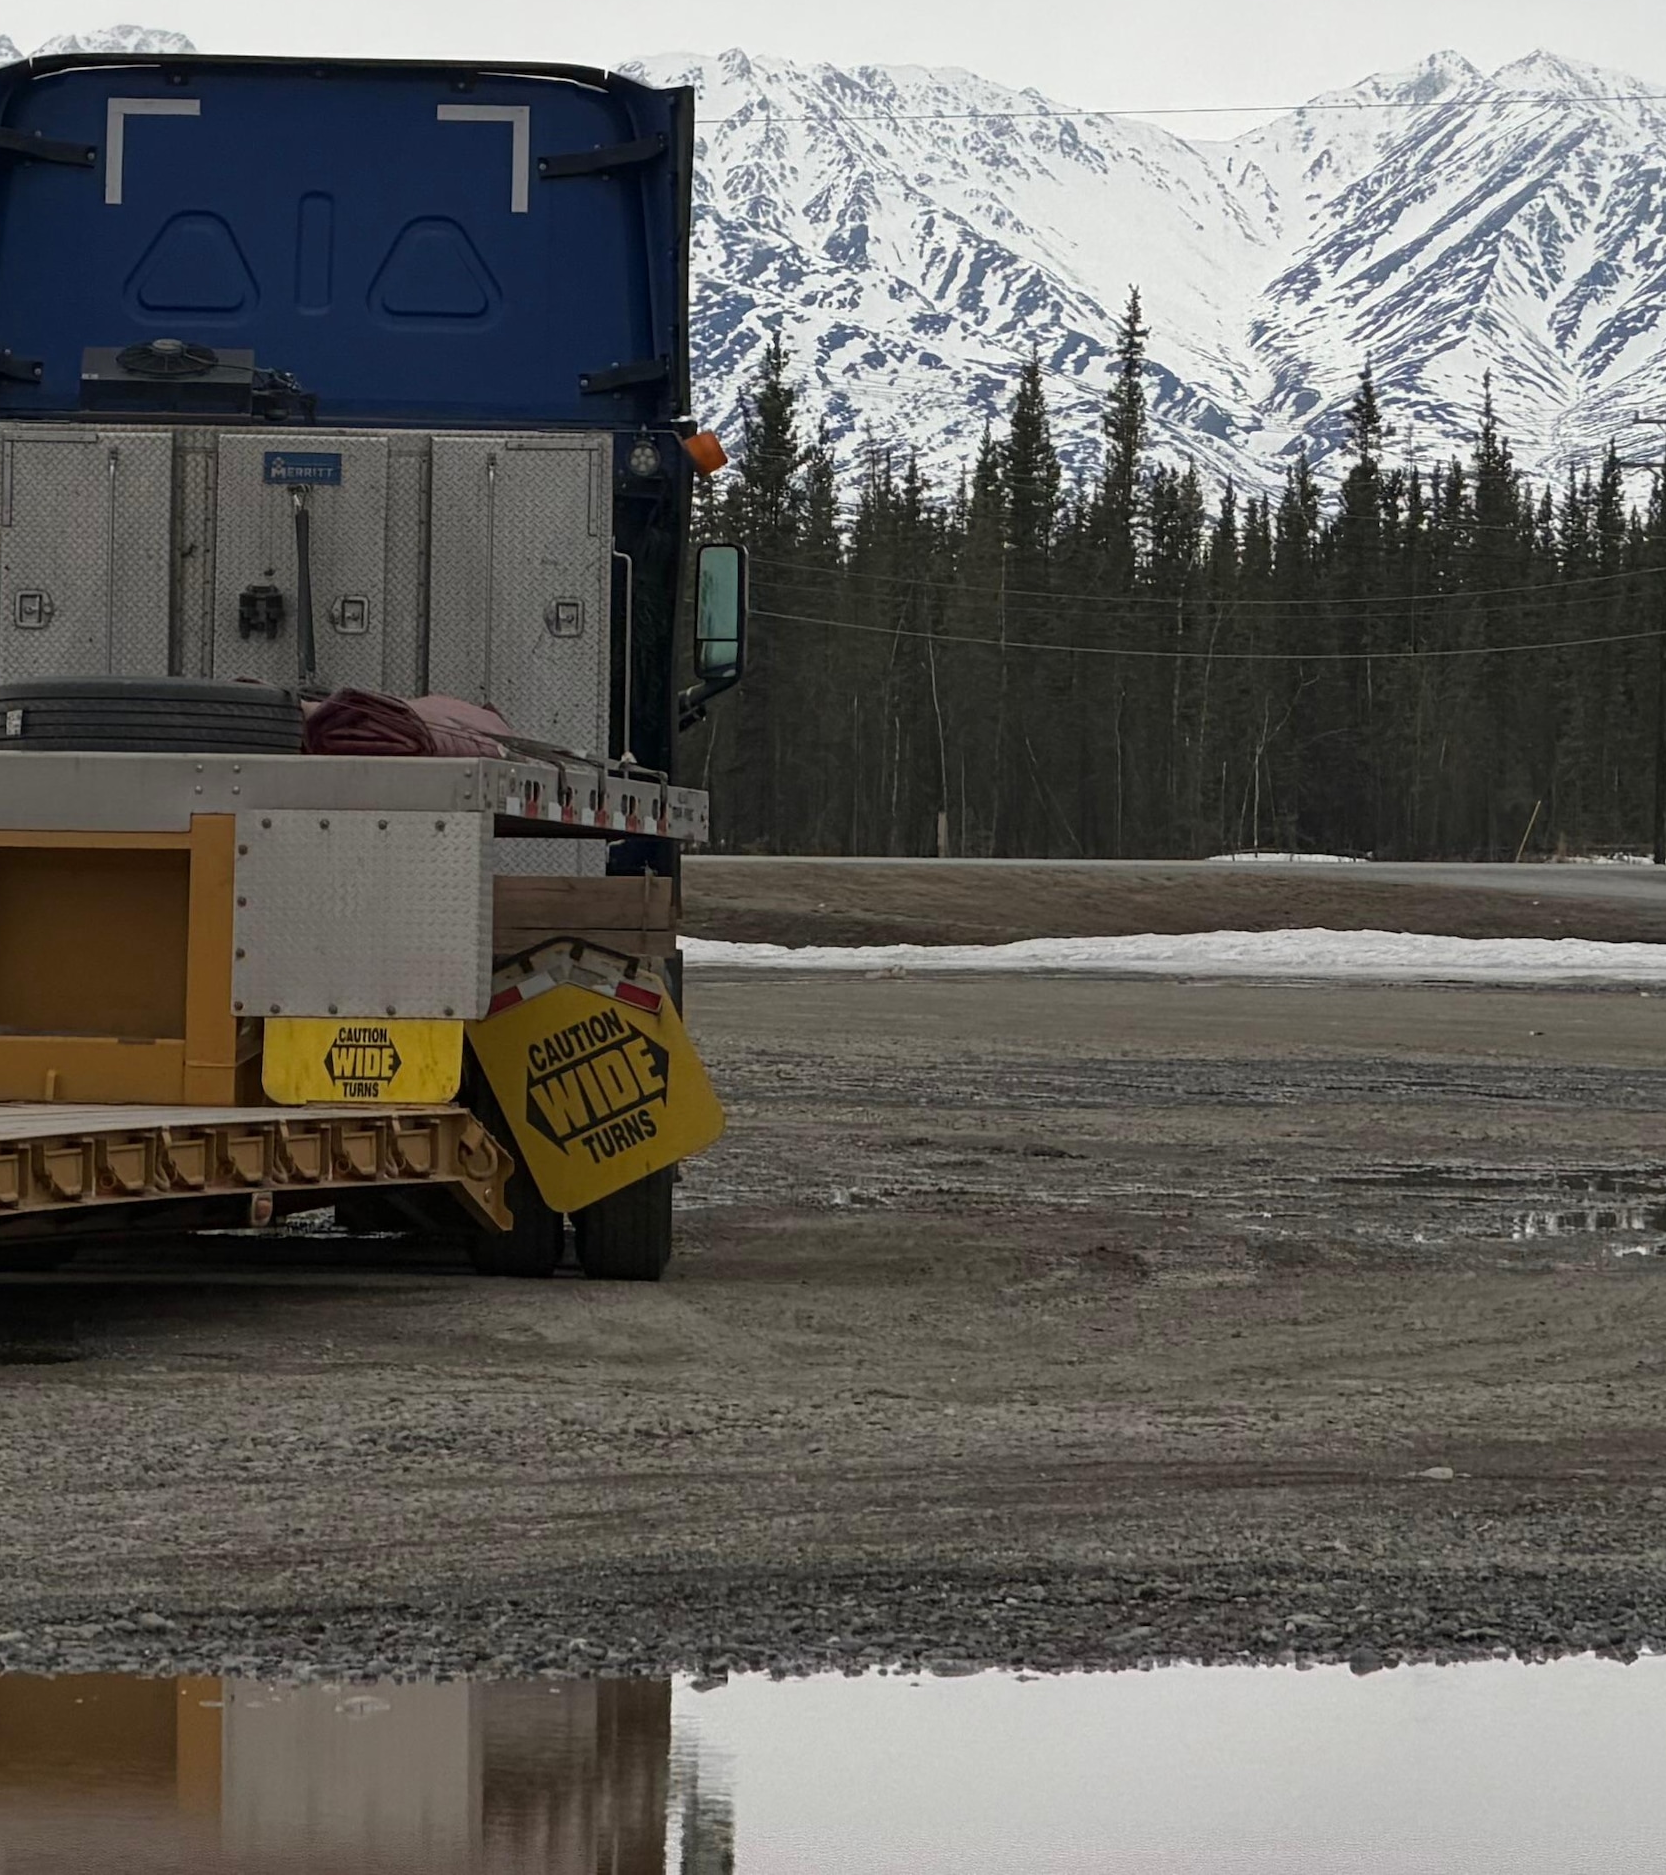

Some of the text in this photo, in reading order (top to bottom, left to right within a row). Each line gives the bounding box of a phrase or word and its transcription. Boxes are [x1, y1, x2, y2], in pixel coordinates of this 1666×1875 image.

[270, 466, 334, 479] MERRITT
[338, 1027, 387, 1043] CAUTION
[528, 1007, 625, 1072] CAUTION
[331, 1047, 394, 1078] WIDE
[342, 1082, 379, 1098] TURNS
[529, 1036, 666, 1139] WIDE
[581, 1109, 657, 1164] TURNS
